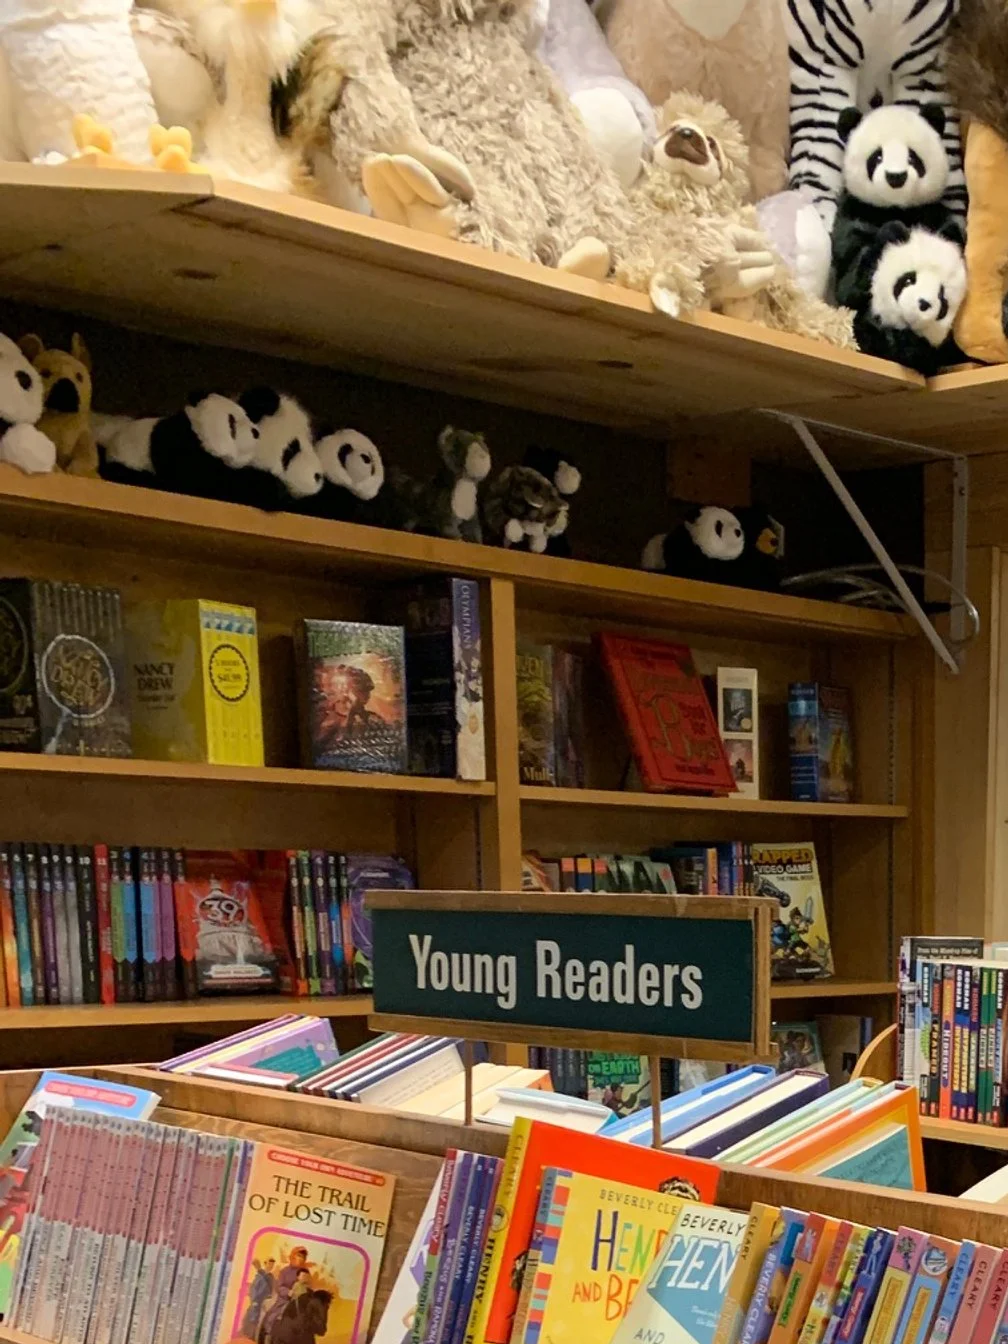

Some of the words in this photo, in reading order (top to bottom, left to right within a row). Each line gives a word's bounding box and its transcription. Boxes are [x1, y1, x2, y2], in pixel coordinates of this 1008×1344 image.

[137, 677, 174, 691] DREW
[408, 934, 517, 1010] Young
[535, 939, 704, 1010] Readers
[602, 1060, 640, 1075] EARTH
[942, 1028, 951, 1080] HIDEOUT
[503, 1134, 525, 1199] CLEARY
[248, 1193, 279, 1214] OF
[282, 1201, 337, 1227] LOST
[341, 1213, 386, 1239] TIME
[273, 1175, 312, 1199] THE
[317, 1184, 372, 1213] TRAIL
[599, 1188, 653, 1210] BEVERLY
[471, 1208, 487, 1245] BEVERLY
[680, 1213, 747, 1238] BEVERLY
[739, 1215, 759, 1261] CLEARY
[474, 1237, 498, 1303] HENRY
[572, 1280, 603, 1304] AND
[752, 1253, 777, 1306] BEVERLY
[947, 1251, 970, 1298] CLEARY
[966, 1259, 988, 1309] CLEARY
